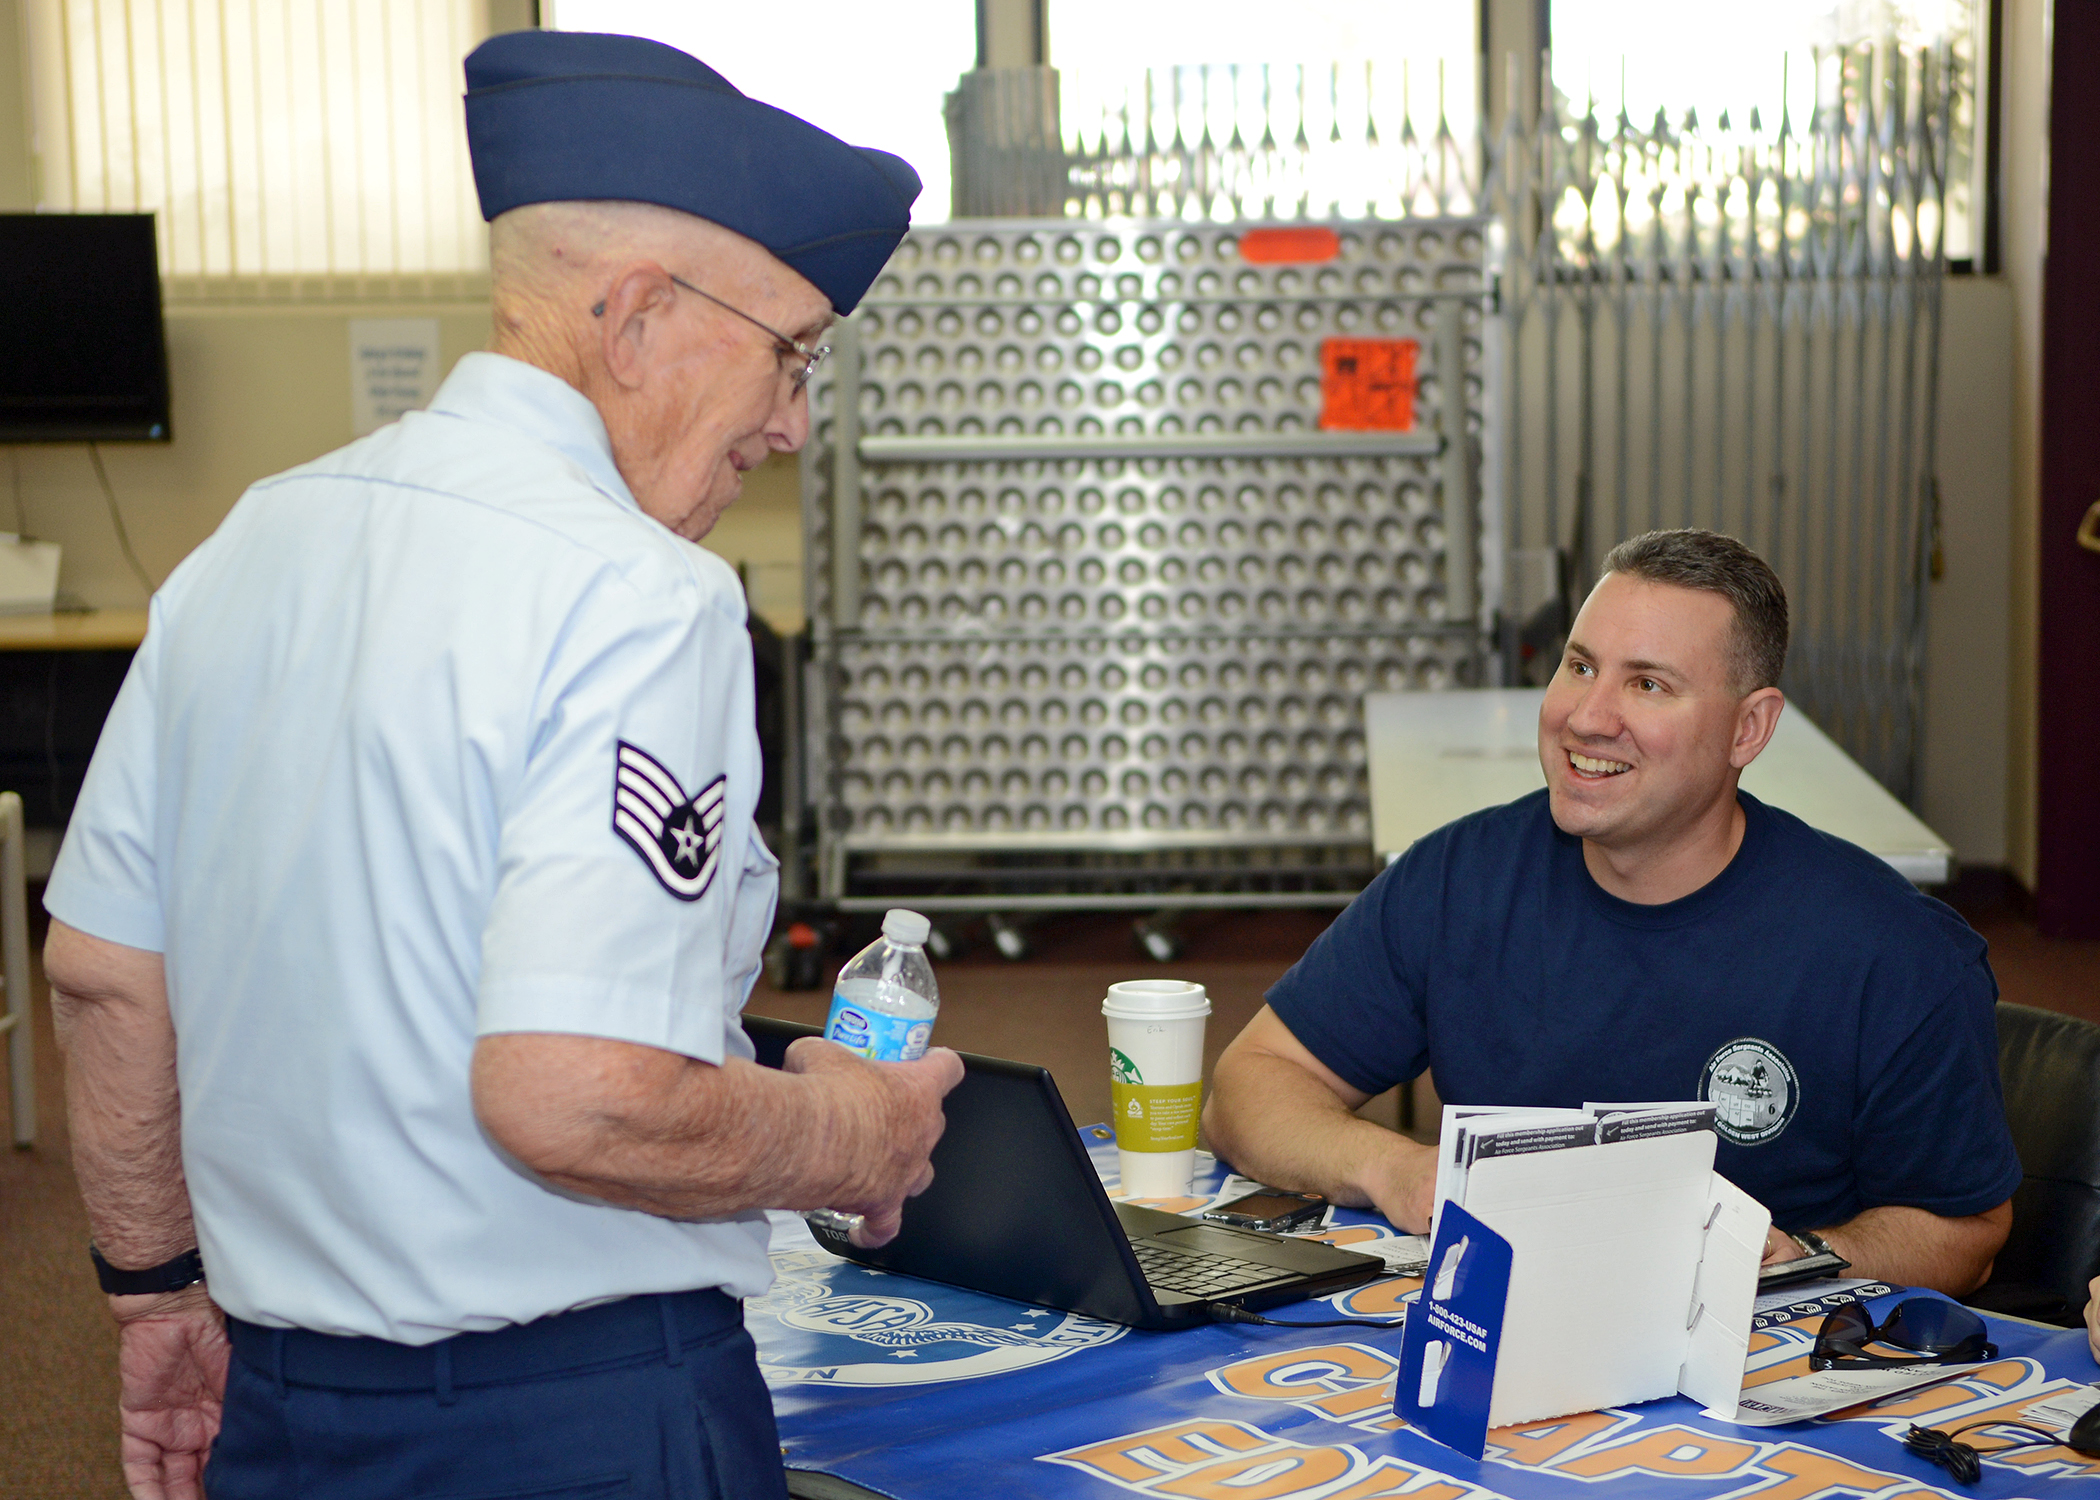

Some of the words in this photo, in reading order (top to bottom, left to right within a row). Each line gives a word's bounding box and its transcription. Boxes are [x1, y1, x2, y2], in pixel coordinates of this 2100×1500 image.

[1715, 1048, 1733, 1063] Force
[1732, 1044, 1764, 1054] Sergeants
[1764, 1049, 1791, 1082] Association
[1768, 1103, 1776, 1115] 6
[1639, 1115, 1669, 1123] membership
[1670, 1111, 1696, 1120] application
[1515, 1129, 1545, 1137] membership
[1546, 1126, 1574, 1135] application
[1620, 1126, 1634, 1134] today
[1645, 1122, 1657, 1130] send
[1668, 1119, 1689, 1128] payment
[1662, 1127, 1687, 1135] Association
[1716, 1120, 1740, 1140] GOLDEN
[1740, 1132, 1760, 1140] WEST
[1760, 1117, 1785, 1138] DIVISION
[1495, 1140, 1509, 1148] today
[1545, 1134, 1567, 1143] payment
[1515, 1145, 1538, 1153] Sergeants
[1538, 1143, 1565, 1151] Association
[796, 1298, 917, 1332] AFSA
[1428, 1300, 1488, 1339] 1-800-423-USAF
[1427, 1313, 1487, 1353] AIRFORCE.COM
